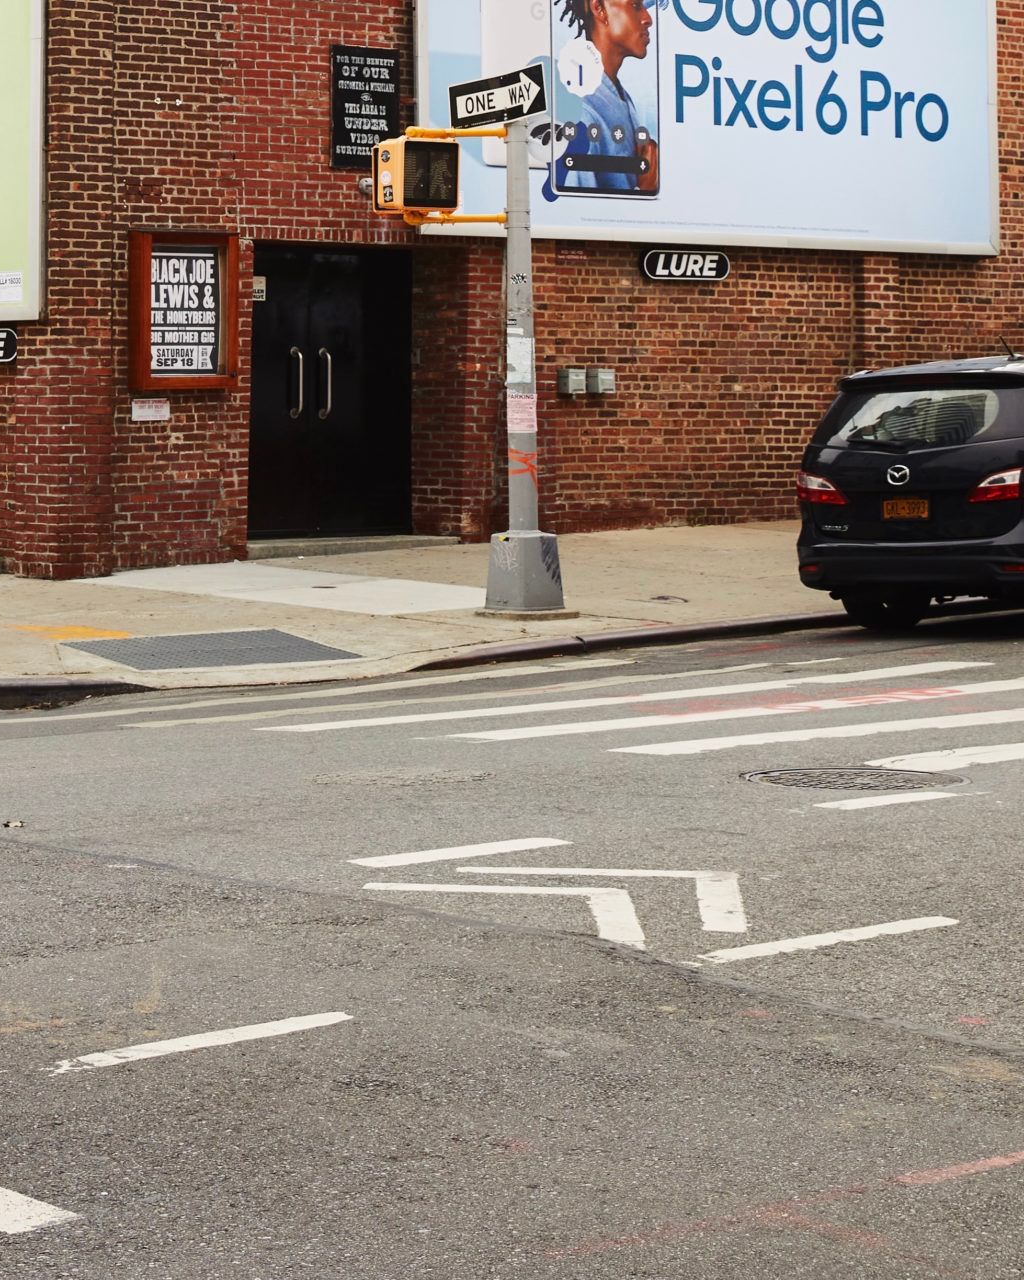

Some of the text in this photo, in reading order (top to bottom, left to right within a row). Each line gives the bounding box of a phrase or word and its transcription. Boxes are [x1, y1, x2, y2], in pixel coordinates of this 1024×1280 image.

[530, 1, 545, 21] G
[336, 55, 395, 67] FOR THE BENEFIT
[342, 65, 390, 79] OF OUR
[465, 82, 532, 114] ONE WAY
[674, 53, 949, 142] Pixel 6 Pro
[344, 102, 386, 116] THIS AREA IS
[344, 117, 389, 131] UNDER
[350, 132, 380, 144] VIDEO
[336, 145, 374, 156] SURVEIL
[565, 157, 574, 167] G
[151, 258, 215, 284] BLACK JOE
[655, 253, 719, 277] LURE
[151, 284, 215, 308] LEWIS &
[151, 310, 216, 325] THE HONEYBEARS
[151, 331, 215, 343] BIG MOTHER GIG
[156, 348, 194, 358] SATURDAY
[156, 358, 178, 367] SEP
[181, 358, 194, 367] 18
